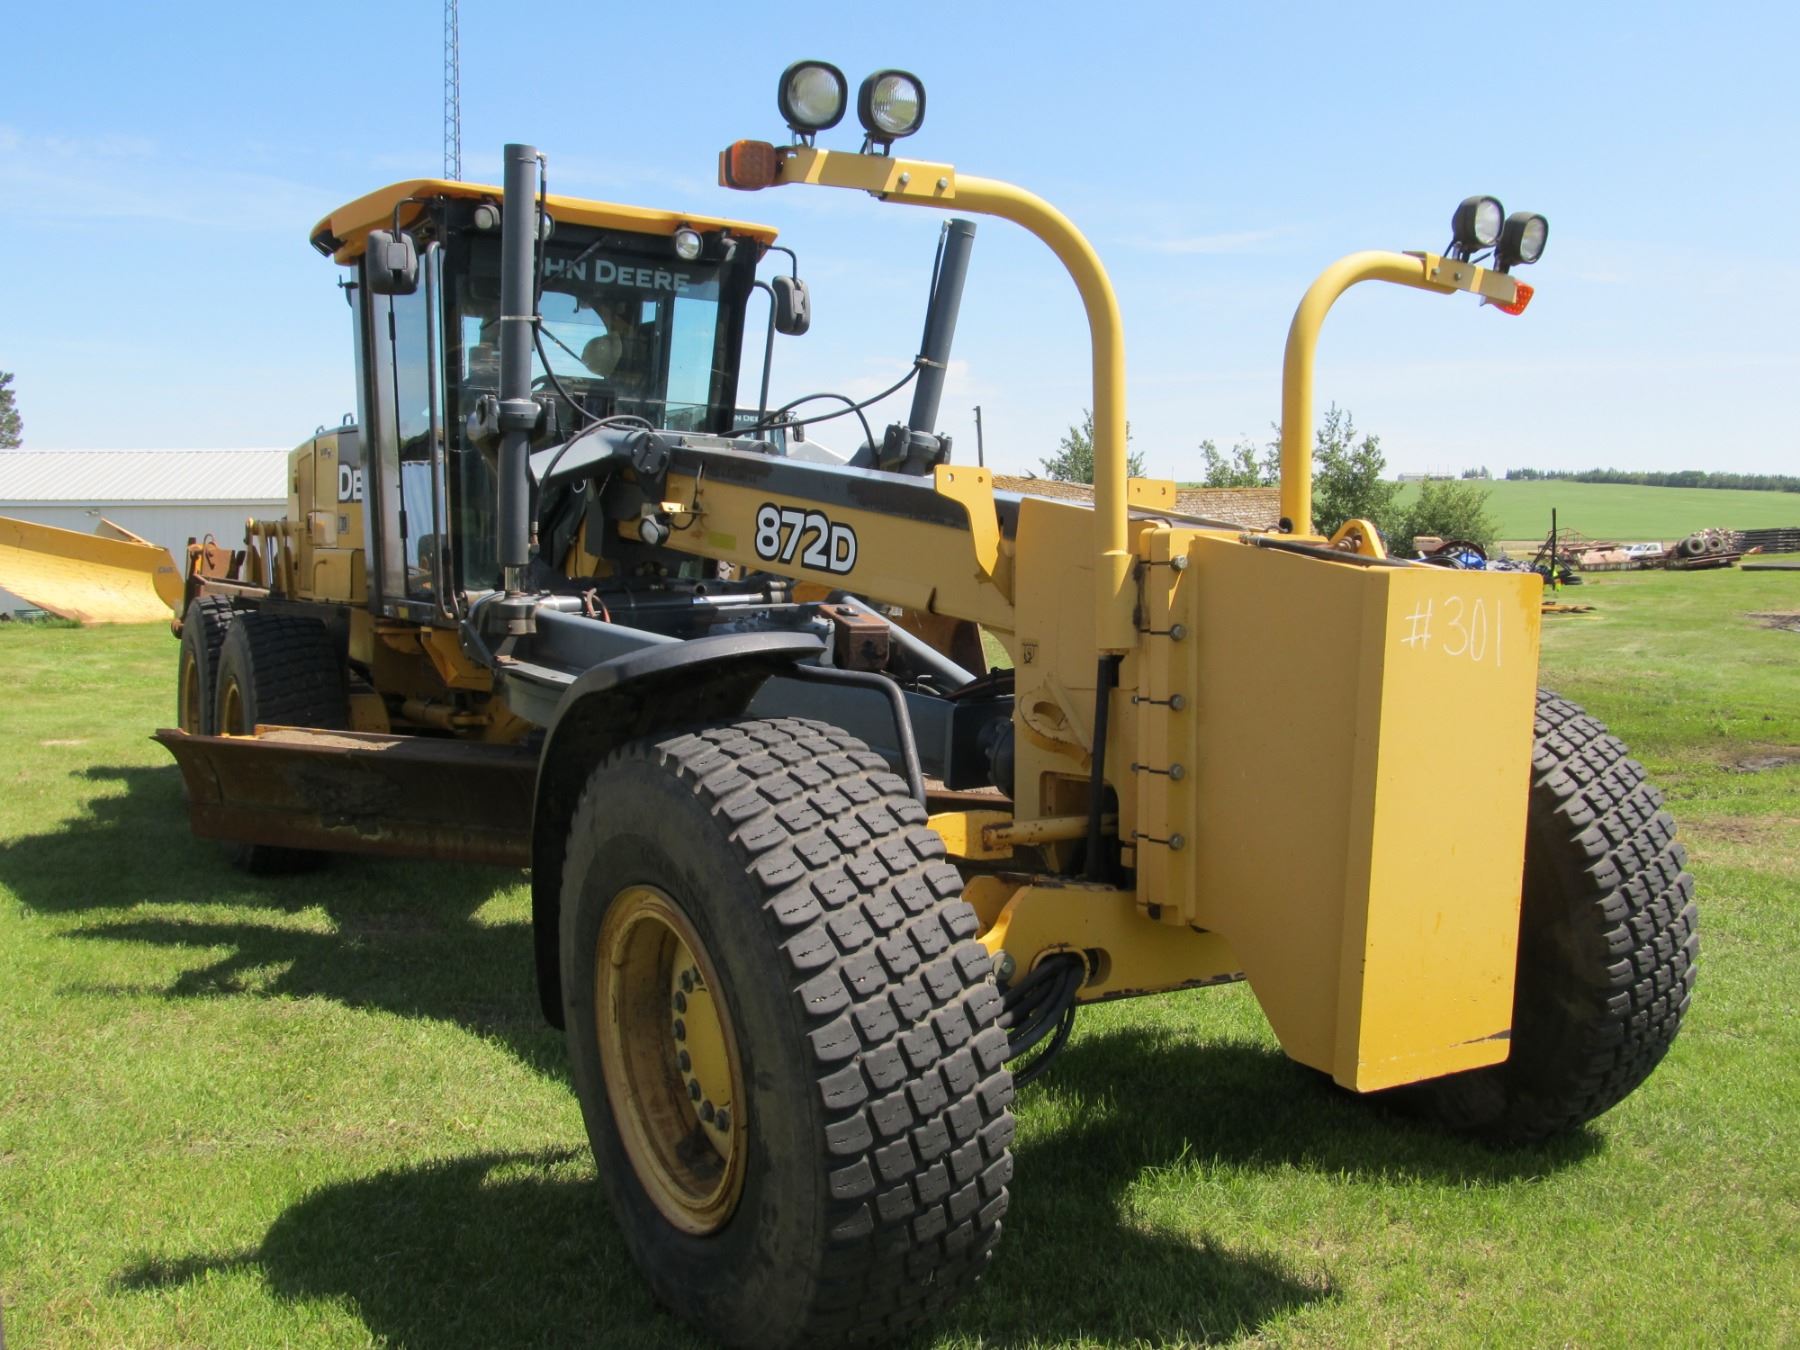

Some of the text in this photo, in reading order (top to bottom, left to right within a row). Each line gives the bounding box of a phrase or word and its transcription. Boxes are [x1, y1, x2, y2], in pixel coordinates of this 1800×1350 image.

[595, 259, 690, 293] DEERE
[755, 502, 858, 576] 872D
[1401, 595, 1500, 667] #301
